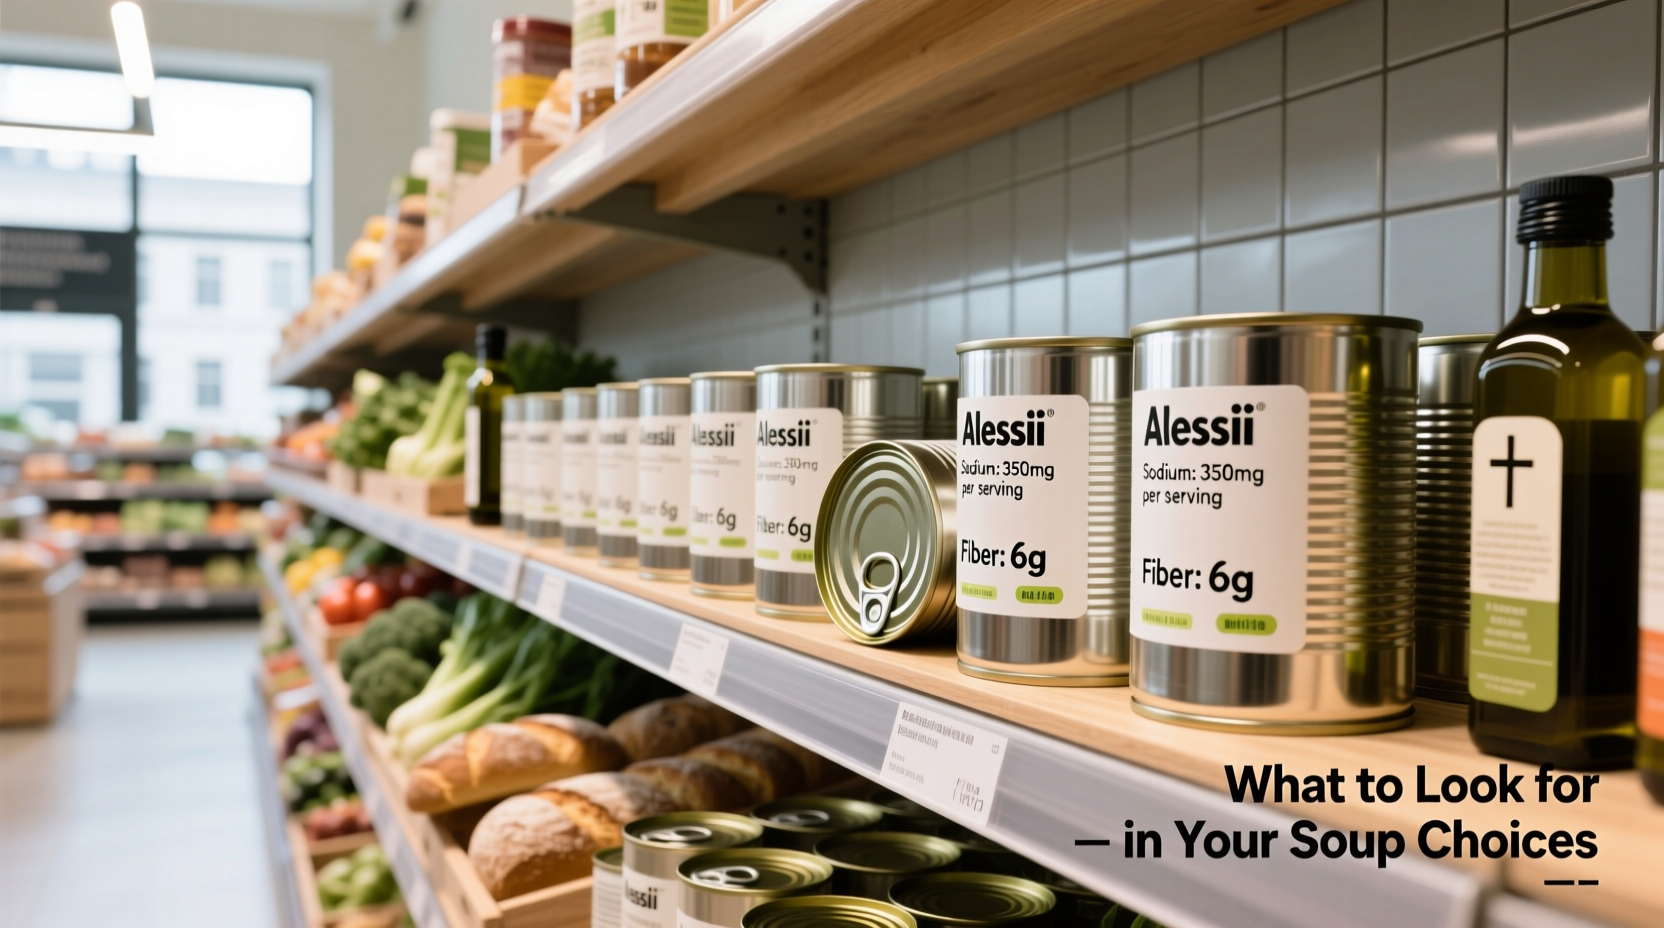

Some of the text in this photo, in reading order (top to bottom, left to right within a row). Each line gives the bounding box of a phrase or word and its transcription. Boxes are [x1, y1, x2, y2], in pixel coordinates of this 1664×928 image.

[1002, 460, 1055, 482] 350mg
[1143, 462, 1264, 487] Sodium: 350mg
[978, 480, 1024, 501] serving
[1143, 486, 1223, 510] per serving
[716, 507, 737, 532] 6g
[788, 516, 812, 543] 6g
[1010, 541, 1046, 578] 6g
[1142, 557, 1254, 603] Fiber: 6g
